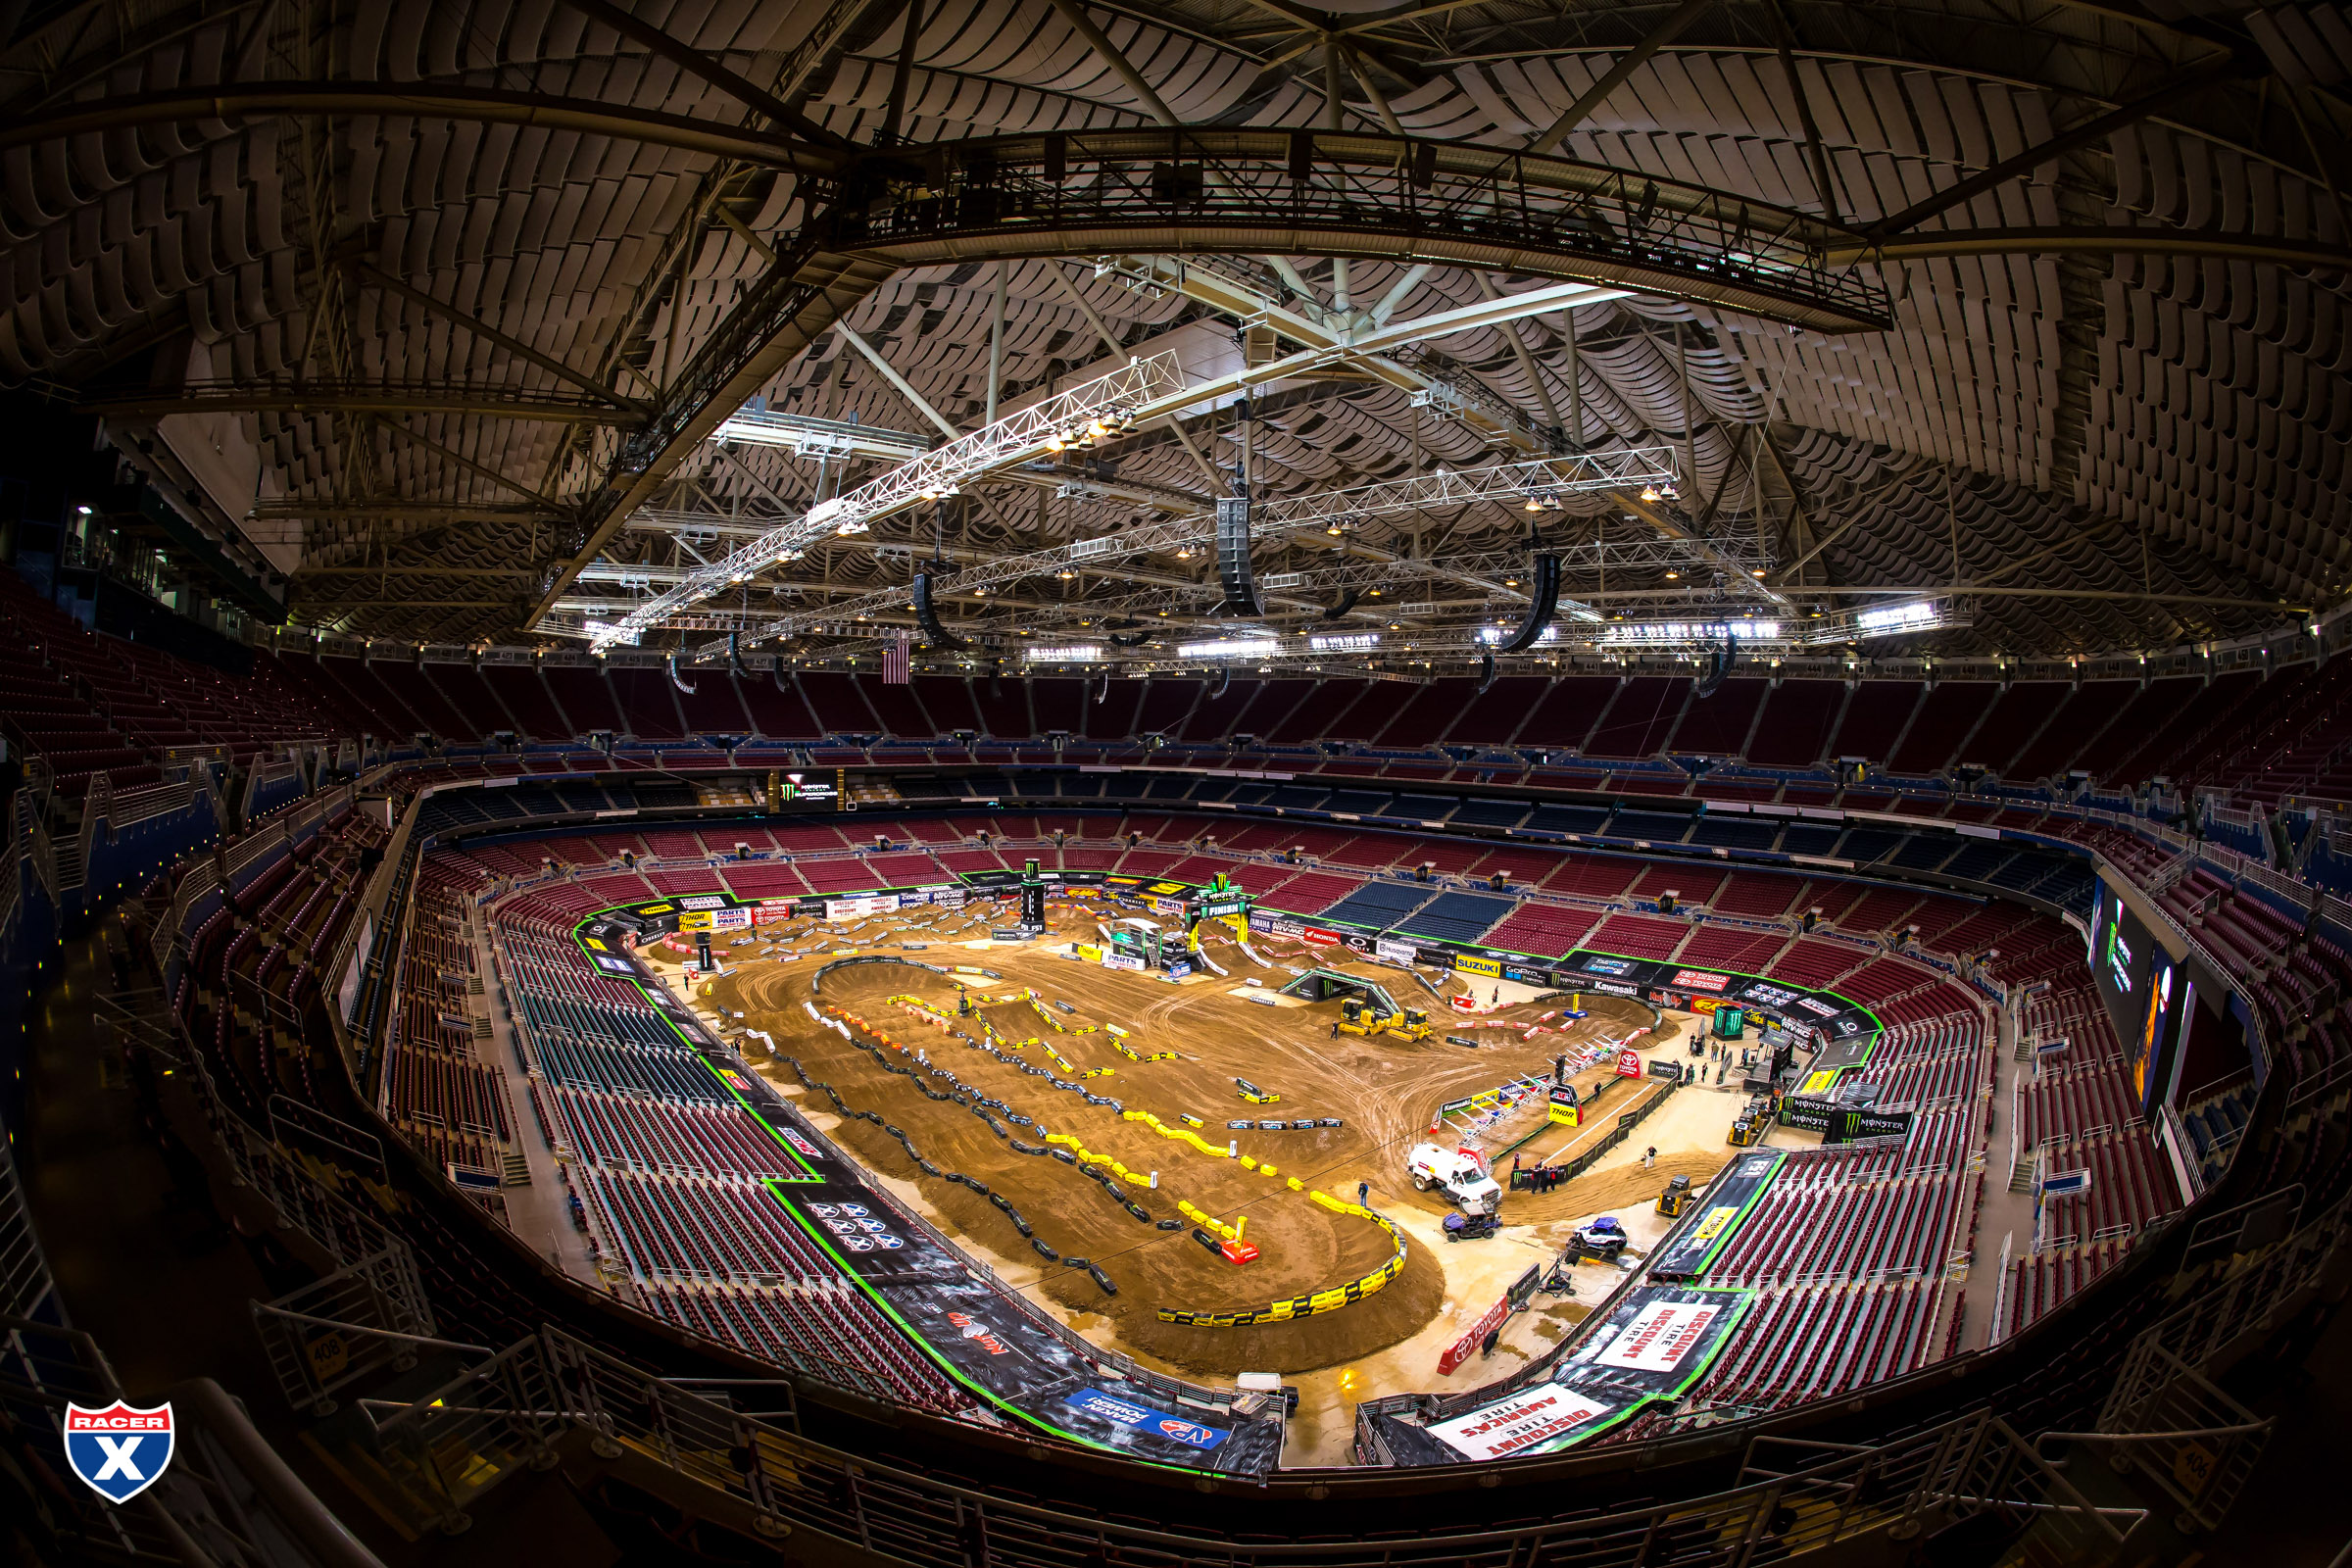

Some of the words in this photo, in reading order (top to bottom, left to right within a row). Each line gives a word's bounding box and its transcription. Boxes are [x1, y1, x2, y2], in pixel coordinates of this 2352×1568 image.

[1156, 900, 1183, 909] PARTS
[1209, 904, 1239, 916] FINISH
[1313, 933, 1340, 943] HONDA
[1108, 954, 1137, 965] PARTS
[1457, 959, 1498, 973] SUZUKI
[1506, 966, 1538, 977] GoPro
[1594, 981, 1638, 996] Kawasaki
[1552, 1107, 1574, 1118] THOR
[1860, 1118, 1904, 1131] MONSTER
[1473, 1304, 1503, 1339] TOYOTA
[1622, 1308, 1677, 1359] DISCOUNT
[1623, 1321, 1649, 1344] TIRE
[1660, 1310, 1713, 1362] DISCOUNT
[1661, 1324, 1686, 1347] TIRE
[315, 1339, 341, 1362] 408
[1086, 1396, 1151, 1420] POWER!
[1460, 1396, 1559, 1438] AMERICA'S
[1479, 1402, 1525, 1421] TIRE
[1486, 1408, 1594, 1456] DISCOUNT
[1506, 1417, 1551, 1438] TIRE
[2185, 1452, 2208, 1479] 406
